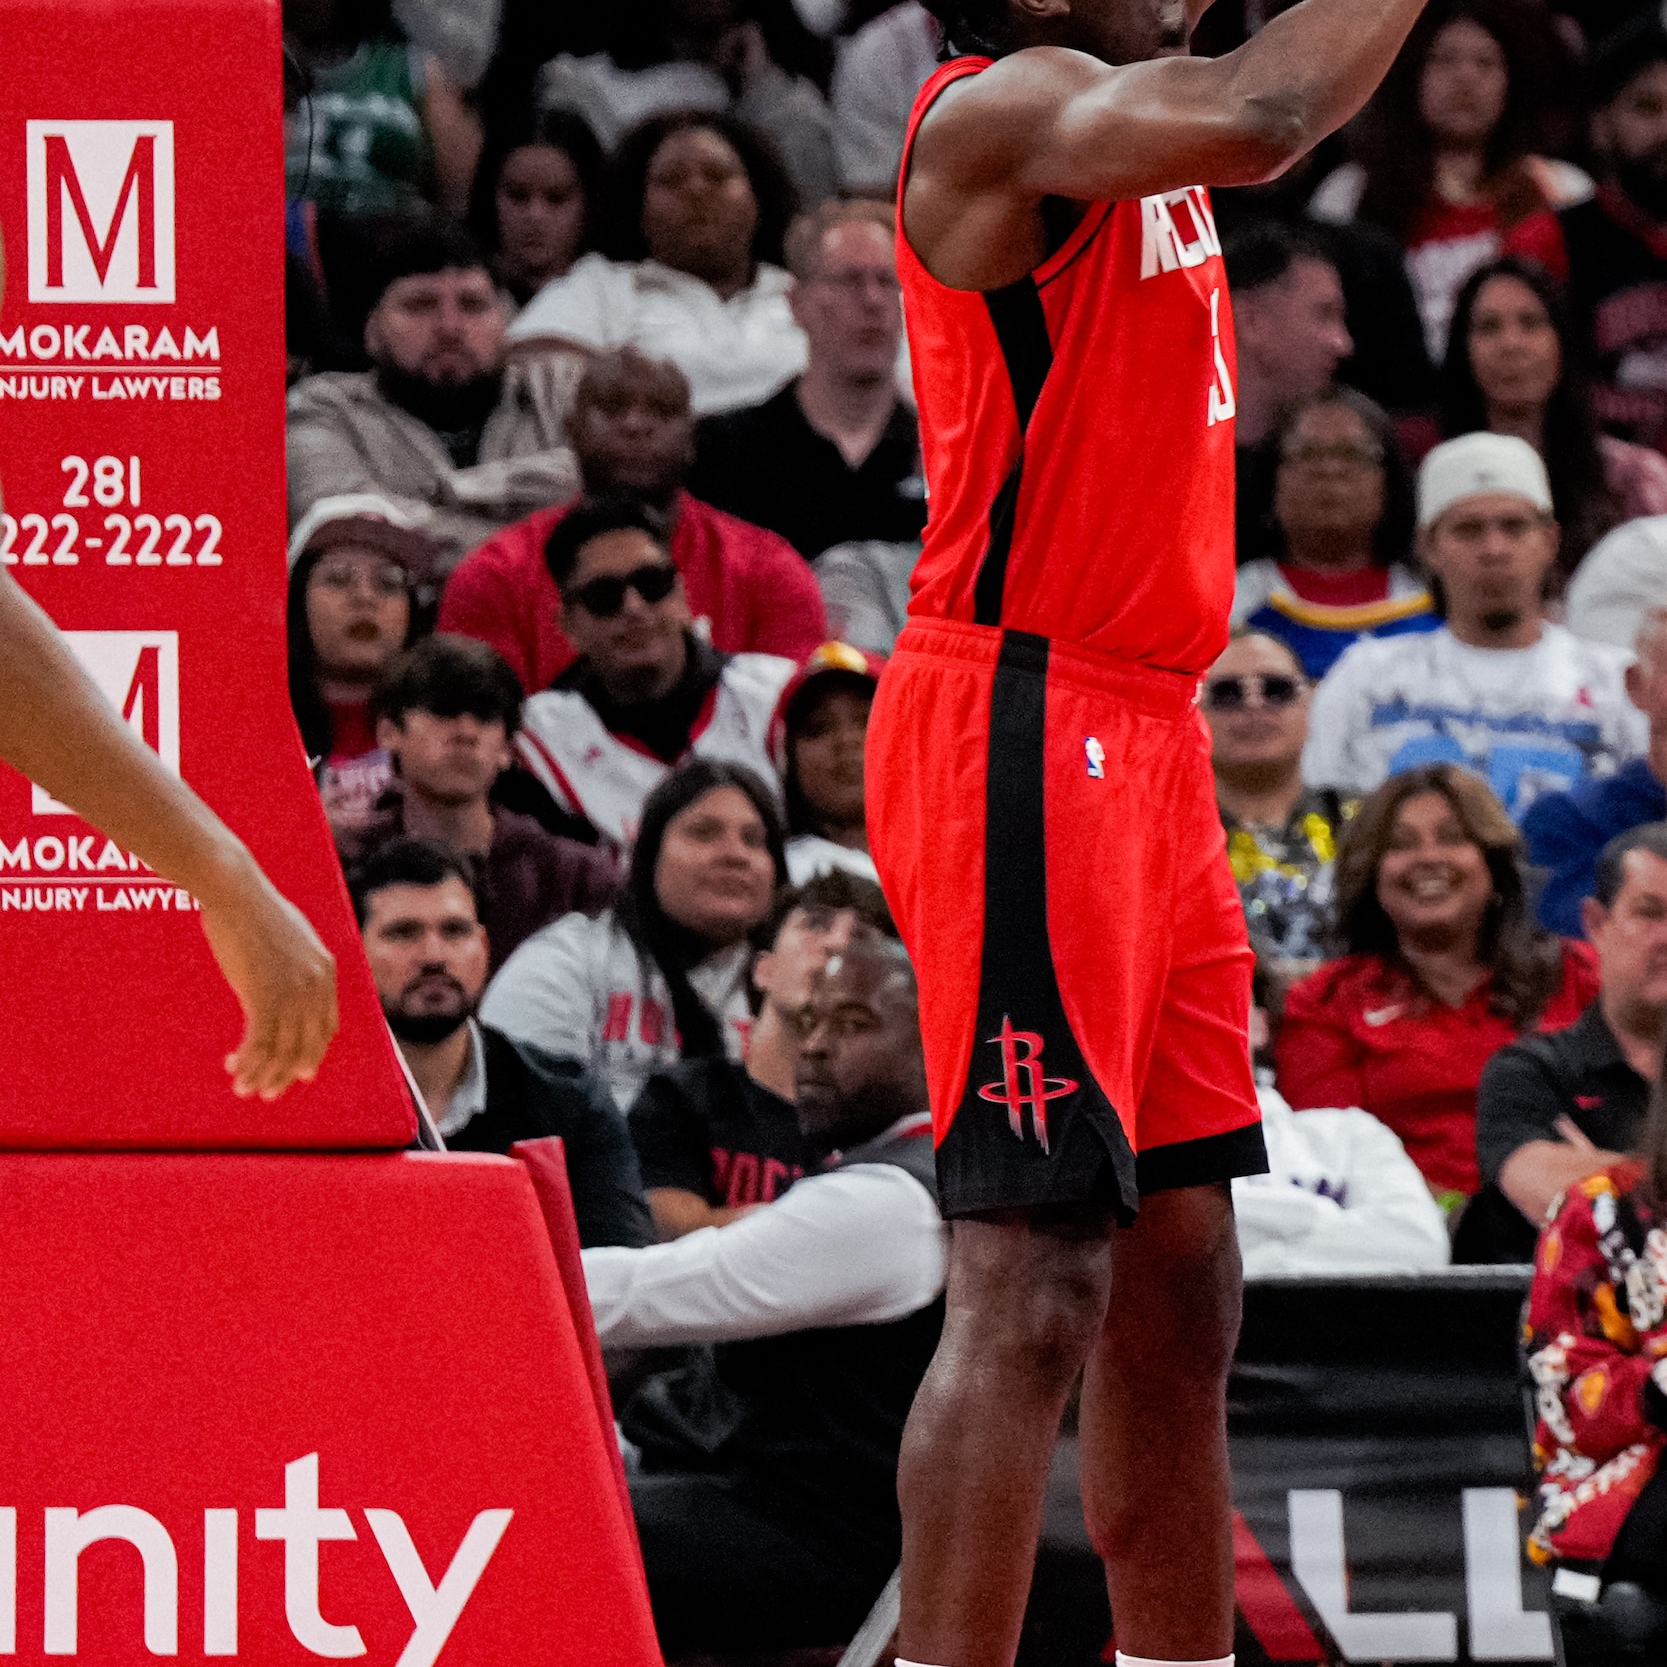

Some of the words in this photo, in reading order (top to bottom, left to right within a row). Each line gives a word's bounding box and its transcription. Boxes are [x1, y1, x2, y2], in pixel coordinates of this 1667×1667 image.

[0, 324, 220, 361] MOKARAM
[0, 375, 85, 401] NJURY
[92, 375, 222, 401] LAWYERS
[61, 454, 141, 508] 281
[0, 513, 223, 566] 222-2222
[1, 887, 89, 912] NJURY
[1234, 1488, 1556, 1663] LL
